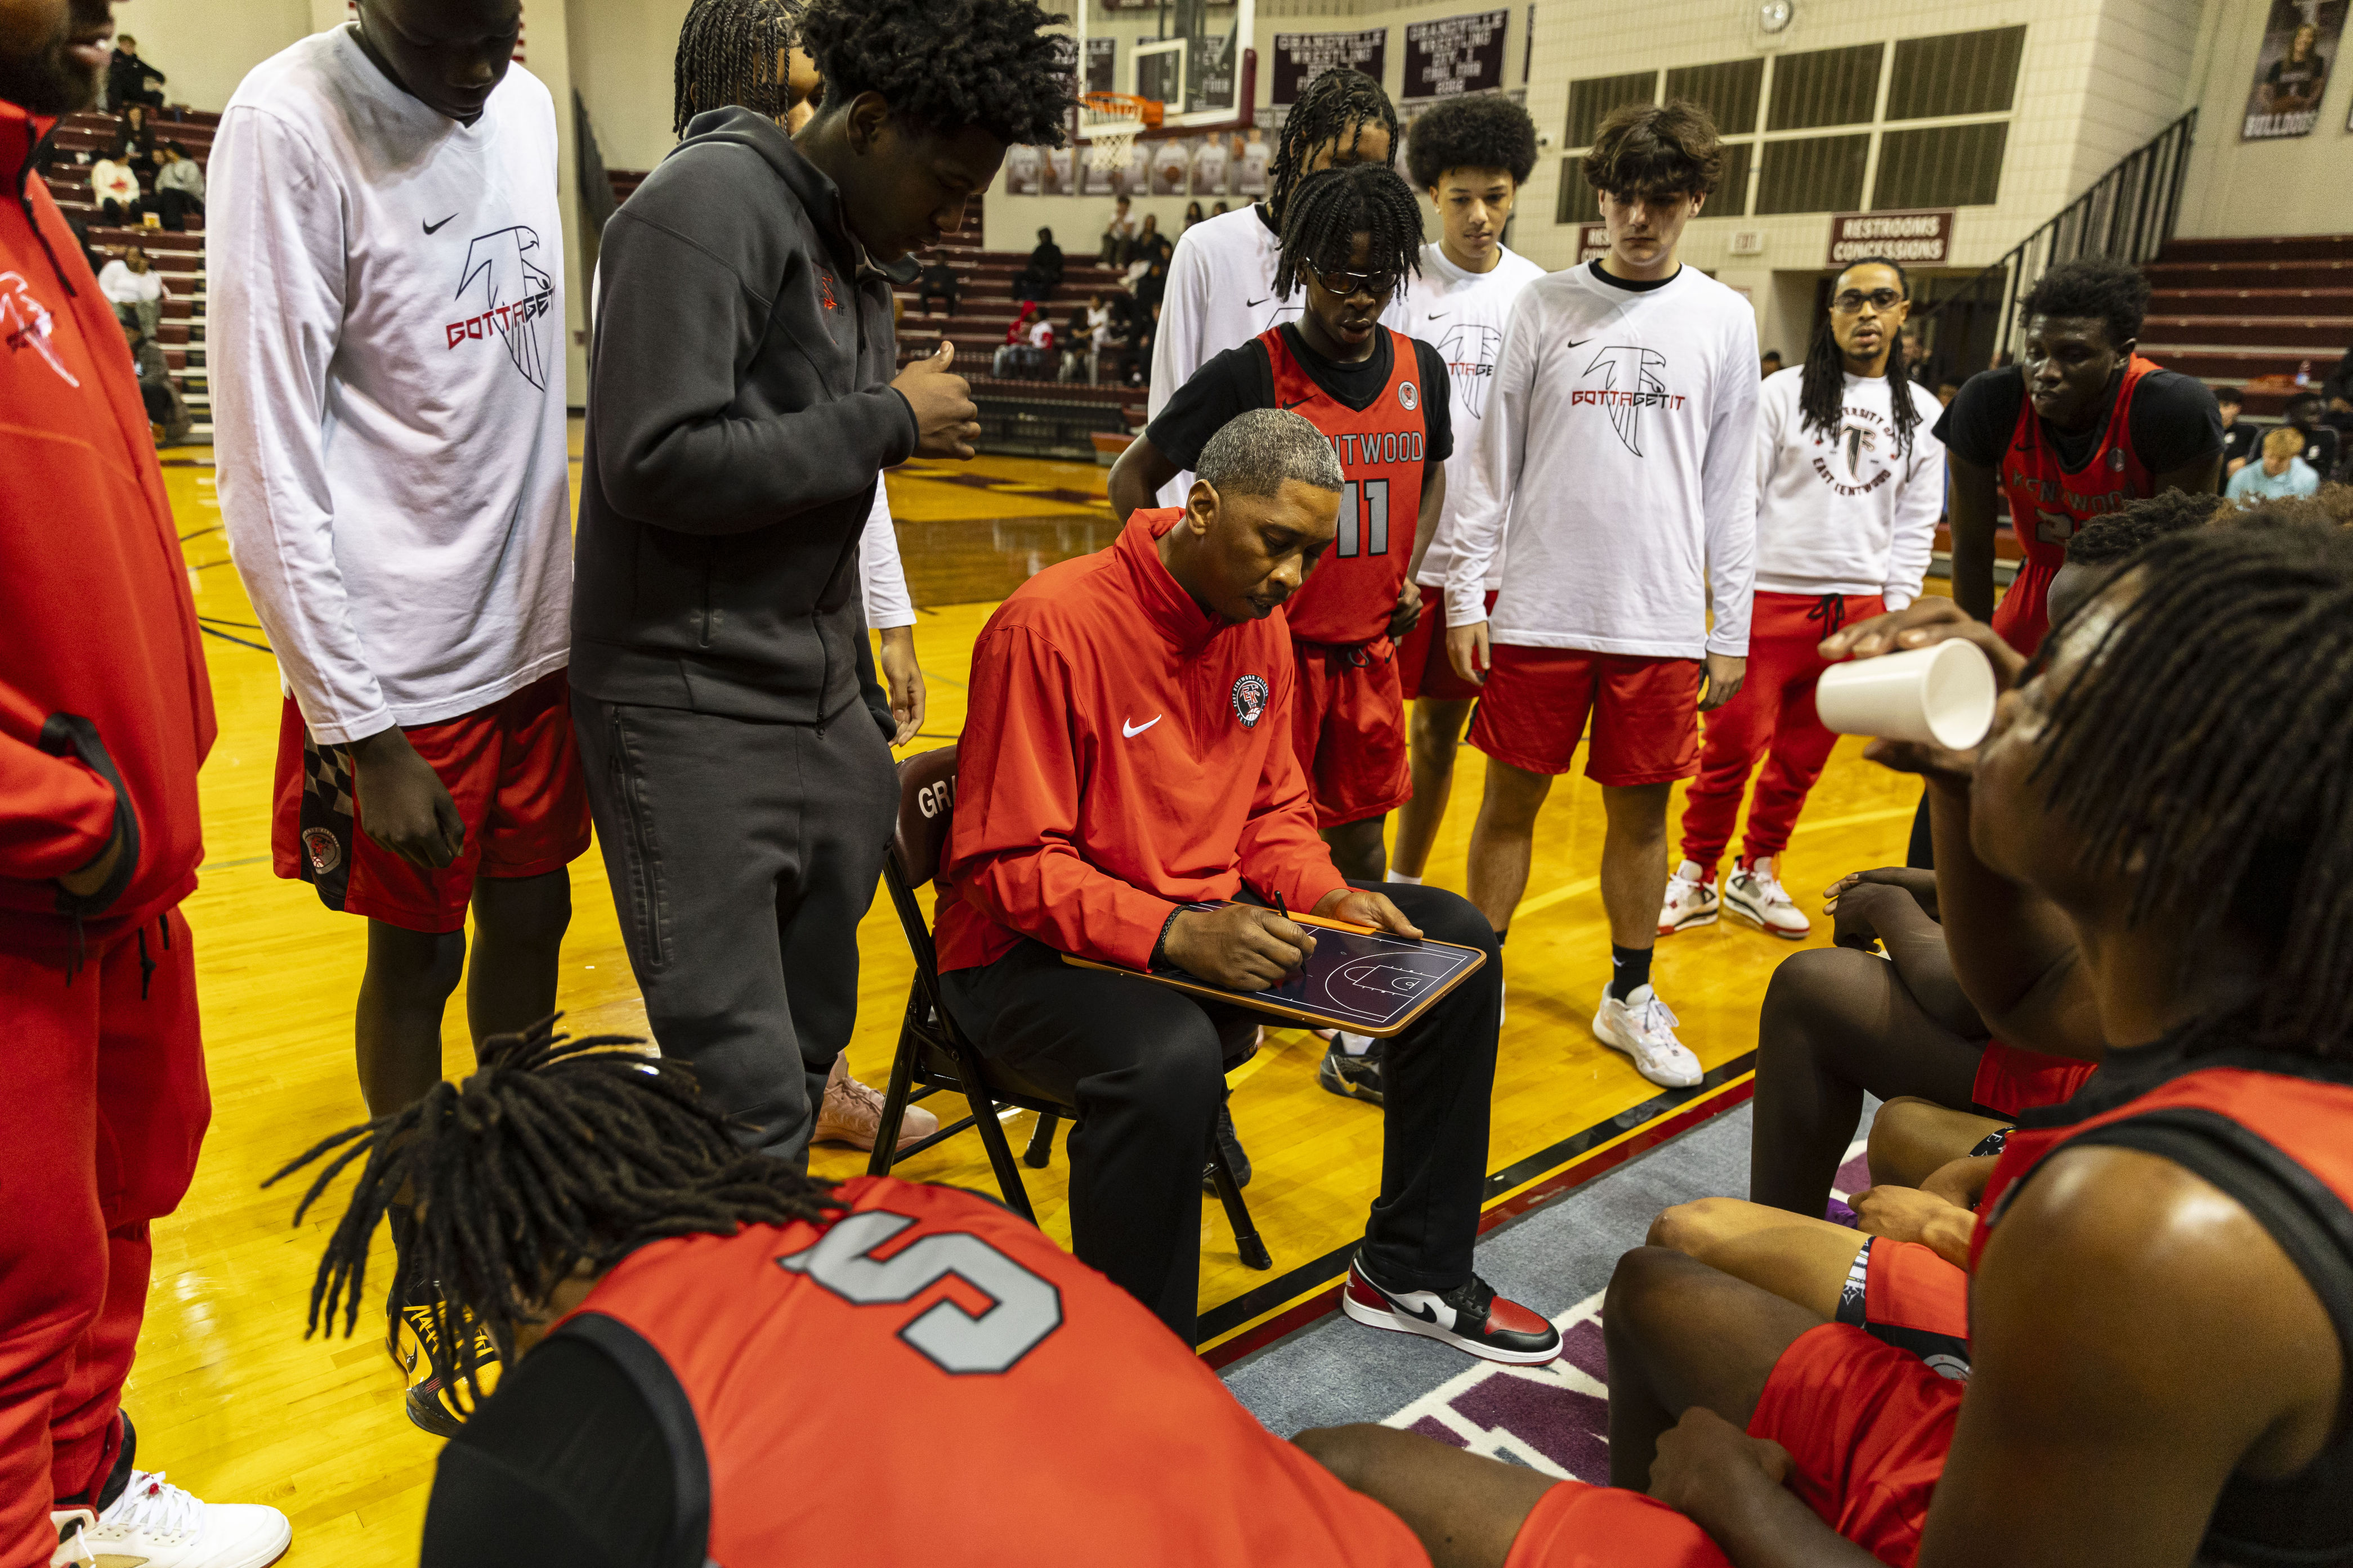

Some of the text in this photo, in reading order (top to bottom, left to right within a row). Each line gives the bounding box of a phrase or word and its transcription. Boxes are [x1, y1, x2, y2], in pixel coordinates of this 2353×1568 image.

[1842, 215, 1940, 239] RESTROOMS
[1833, 239, 1943, 261] CONCESSIONS
[1325, 431, 1424, 465] NTWOOD
[1813, 457, 1835, 484] EAST
[1336, 478, 1390, 559] 11
[1232, 675, 1255, 692] KENTWOOD
[1256, 677, 1268, 697] FALCONS
[775, 1209, 1066, 1376] 5
